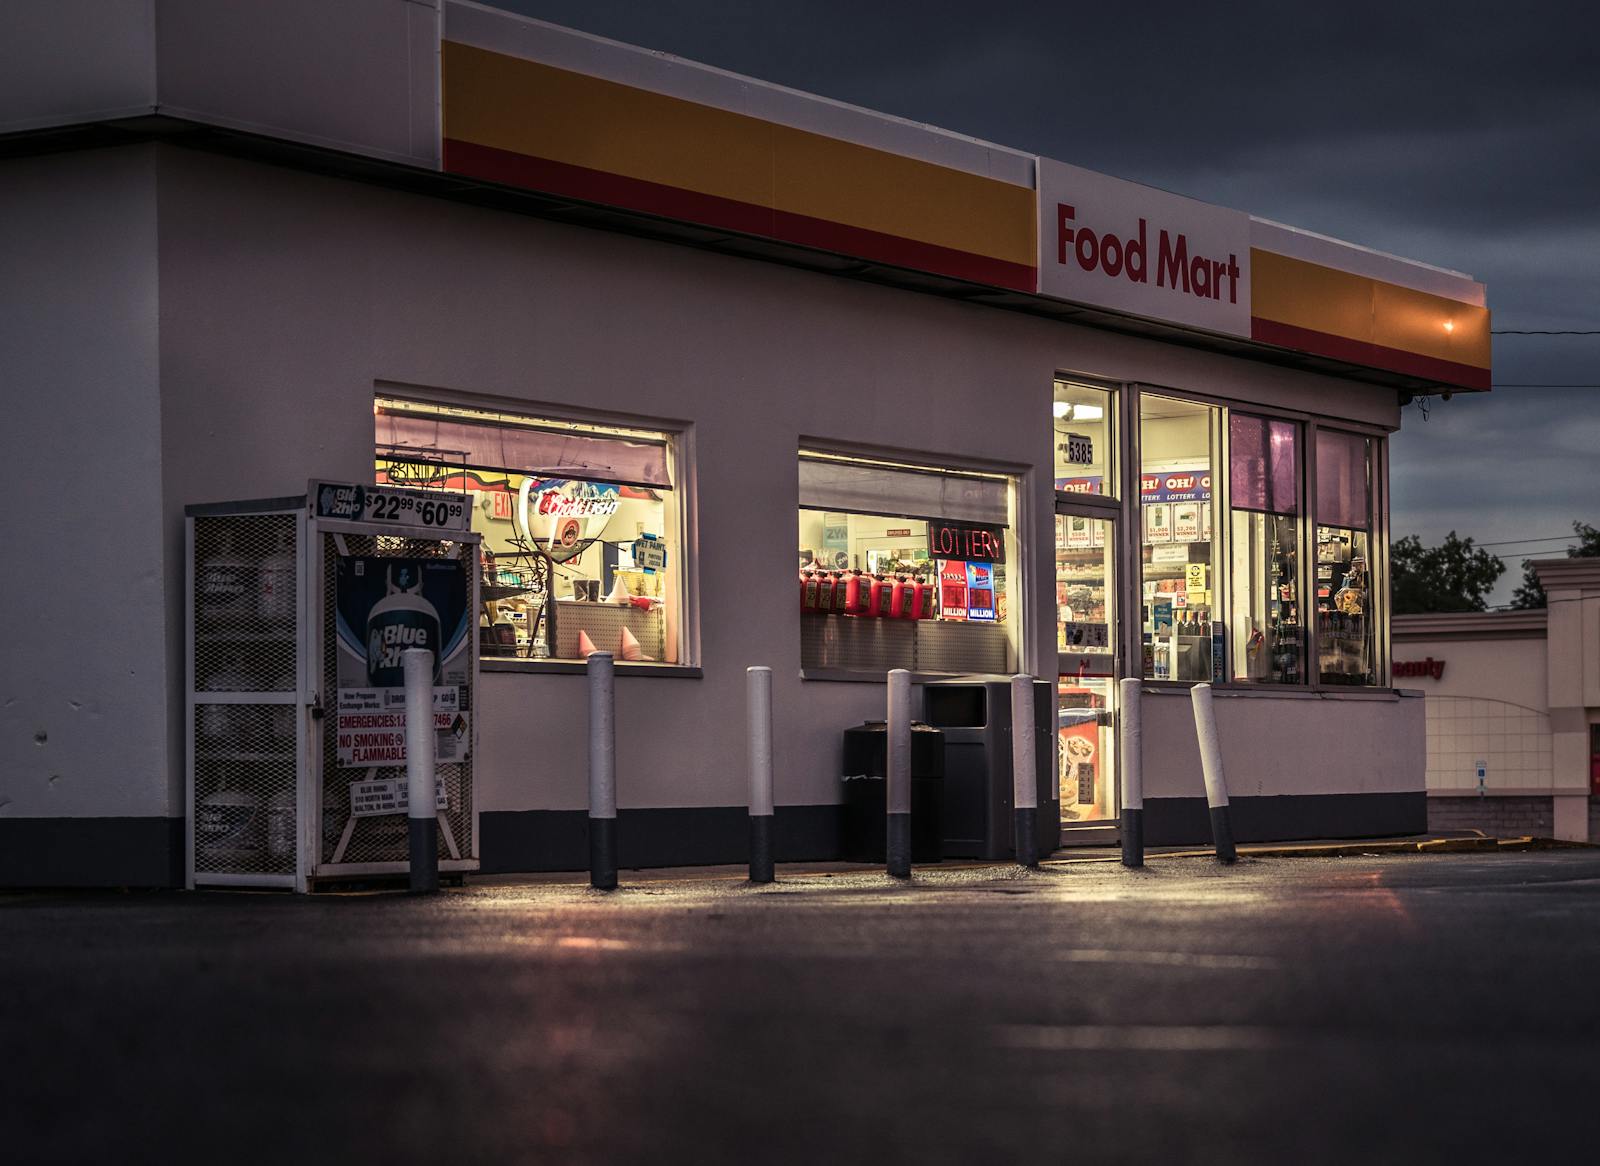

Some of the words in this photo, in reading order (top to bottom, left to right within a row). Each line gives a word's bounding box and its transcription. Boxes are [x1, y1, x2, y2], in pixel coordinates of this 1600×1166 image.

[1058, 203, 1147, 283] Food
[1157, 229, 1240, 304] Mart
[1069, 441, 1093, 464] 5385
[1166, 476, 1194, 489] OH!
[931, 526, 1000, 558] LOTTERY
[943, 607, 967, 616] MILLION
[970, 608, 993, 618] MILLION
[384, 624, 427, 645] Blue
[340, 735, 352, 748] NO
[354, 733, 394, 748] SMOKING
[353, 747, 406, 762] FLAMMABLE
